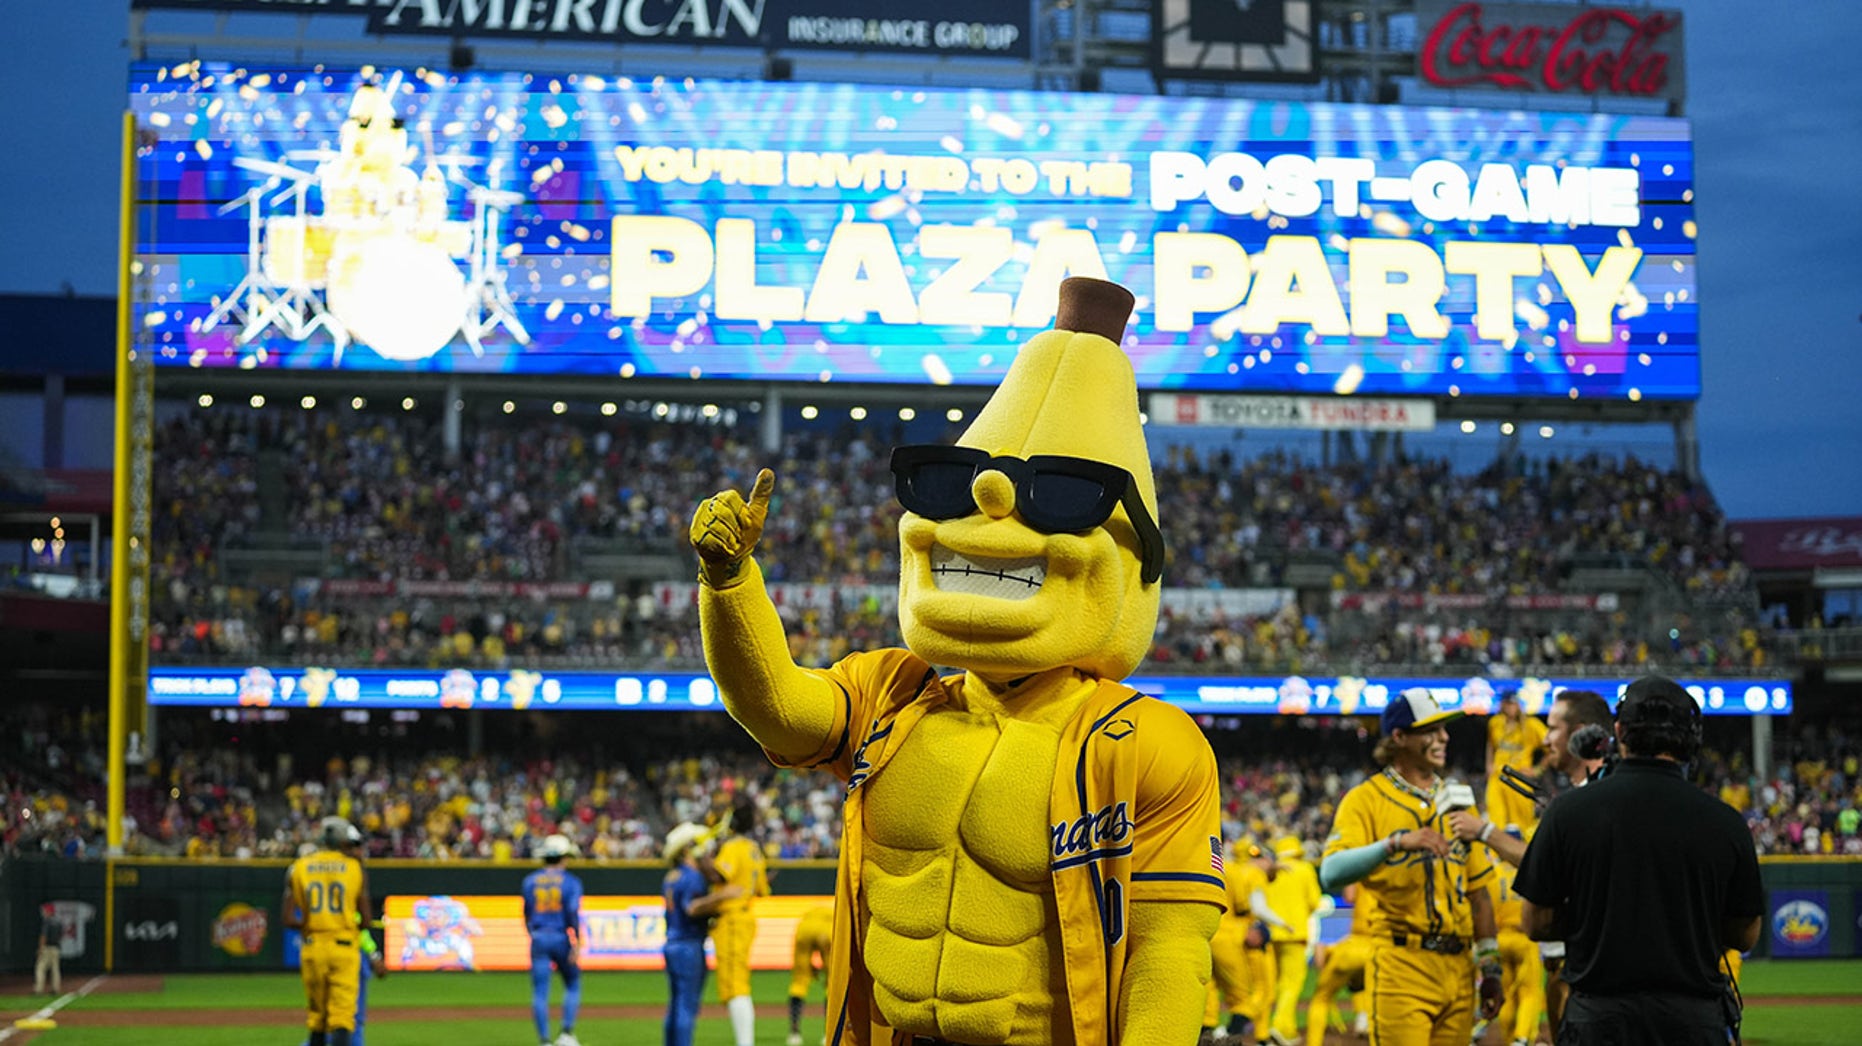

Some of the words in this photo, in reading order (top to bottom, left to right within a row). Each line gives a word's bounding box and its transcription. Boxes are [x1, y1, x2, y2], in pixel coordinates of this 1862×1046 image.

[788, 16, 930, 47] INSURANCE
[934, 21, 1019, 49] GROUP
[788, 153, 968, 191] INVITED
[973, 159, 1037, 194] TO
[1041, 161, 1132, 196] THE
[1150, 151, 1640, 227] POST-GAME
[611, 214, 1109, 327] PLAZA
[1154, 232, 1643, 343] PARTY
[1209, 400, 1299, 423] TOYOTA
[1310, 402, 1409, 424] TUNDRA
